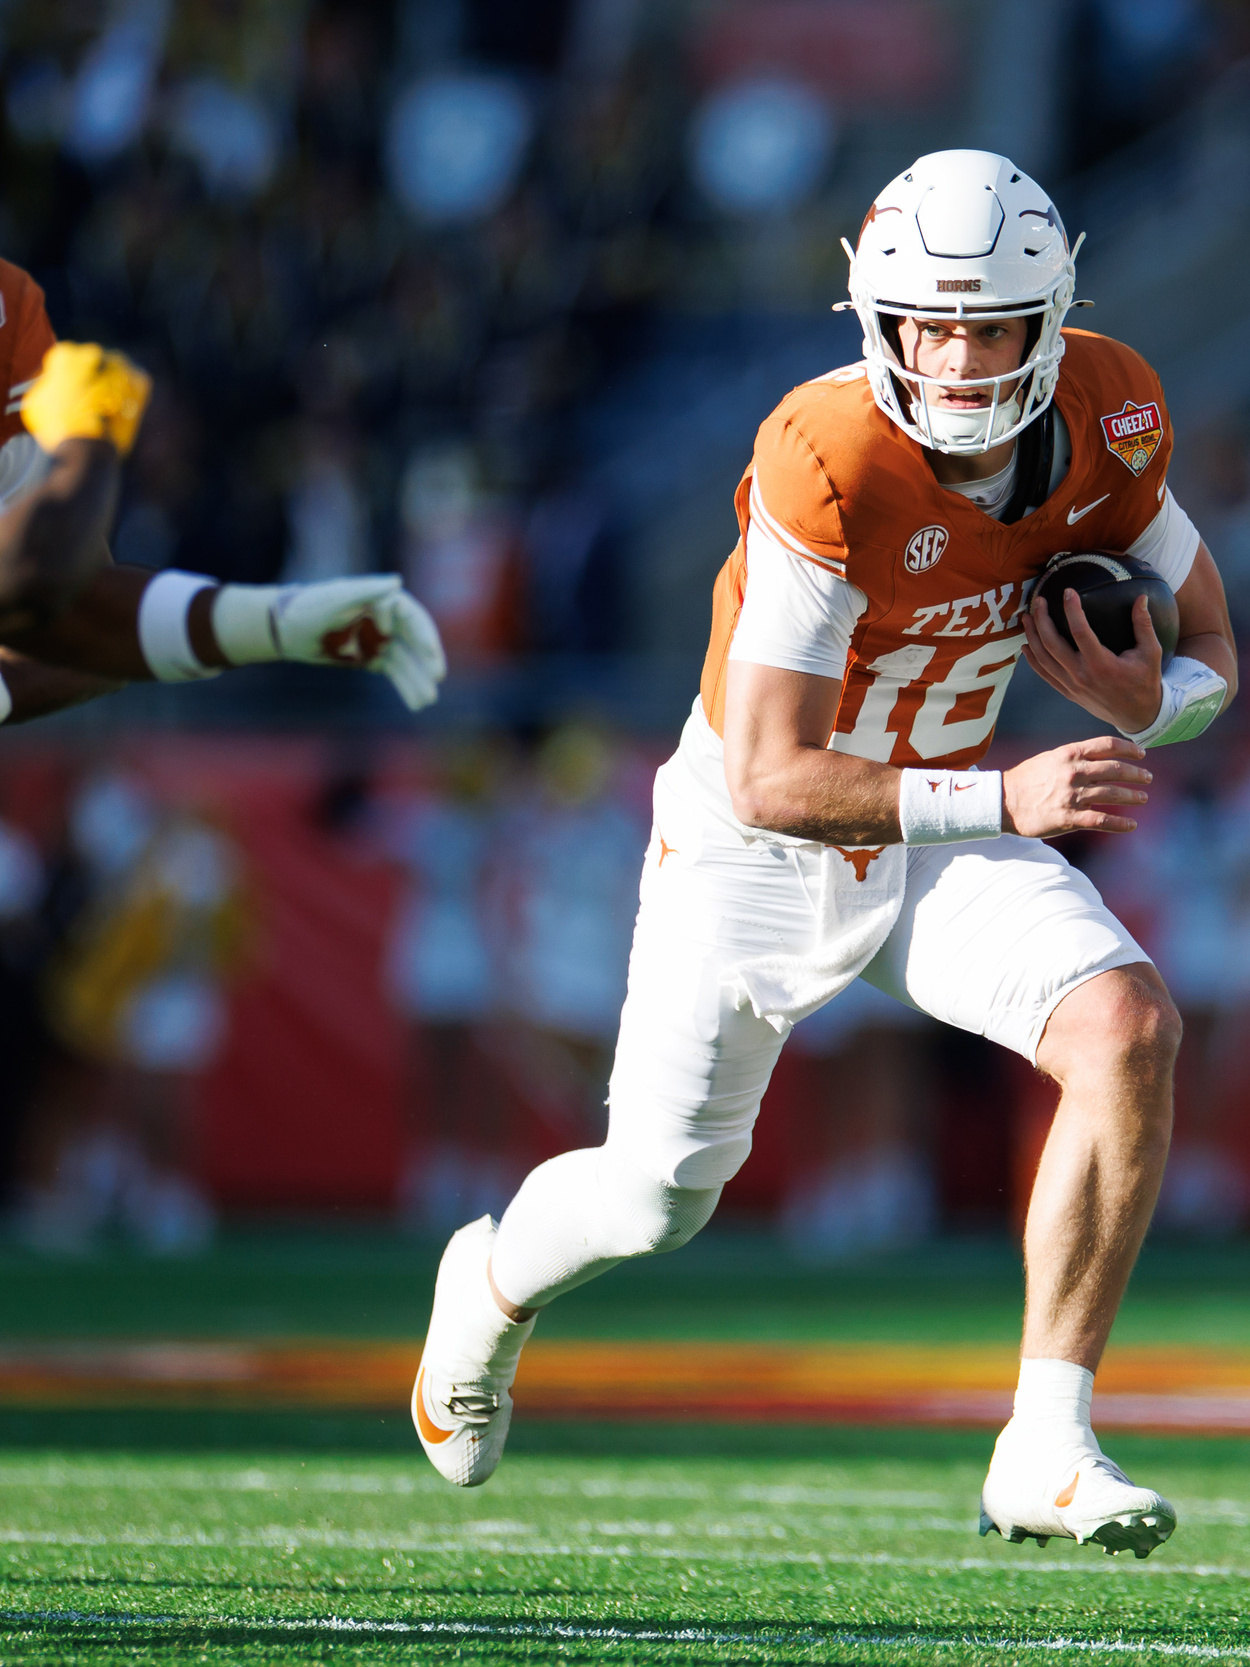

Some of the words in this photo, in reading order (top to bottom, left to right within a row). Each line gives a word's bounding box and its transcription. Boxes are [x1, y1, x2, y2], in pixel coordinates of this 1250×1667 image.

[936, 279, 982, 293] HORNS
[1118, 438, 1139, 450] CITRUS
[1141, 434, 1156, 445] BOWL
[909, 529, 946, 570] SEC
[827, 632, 1029, 764] 16
